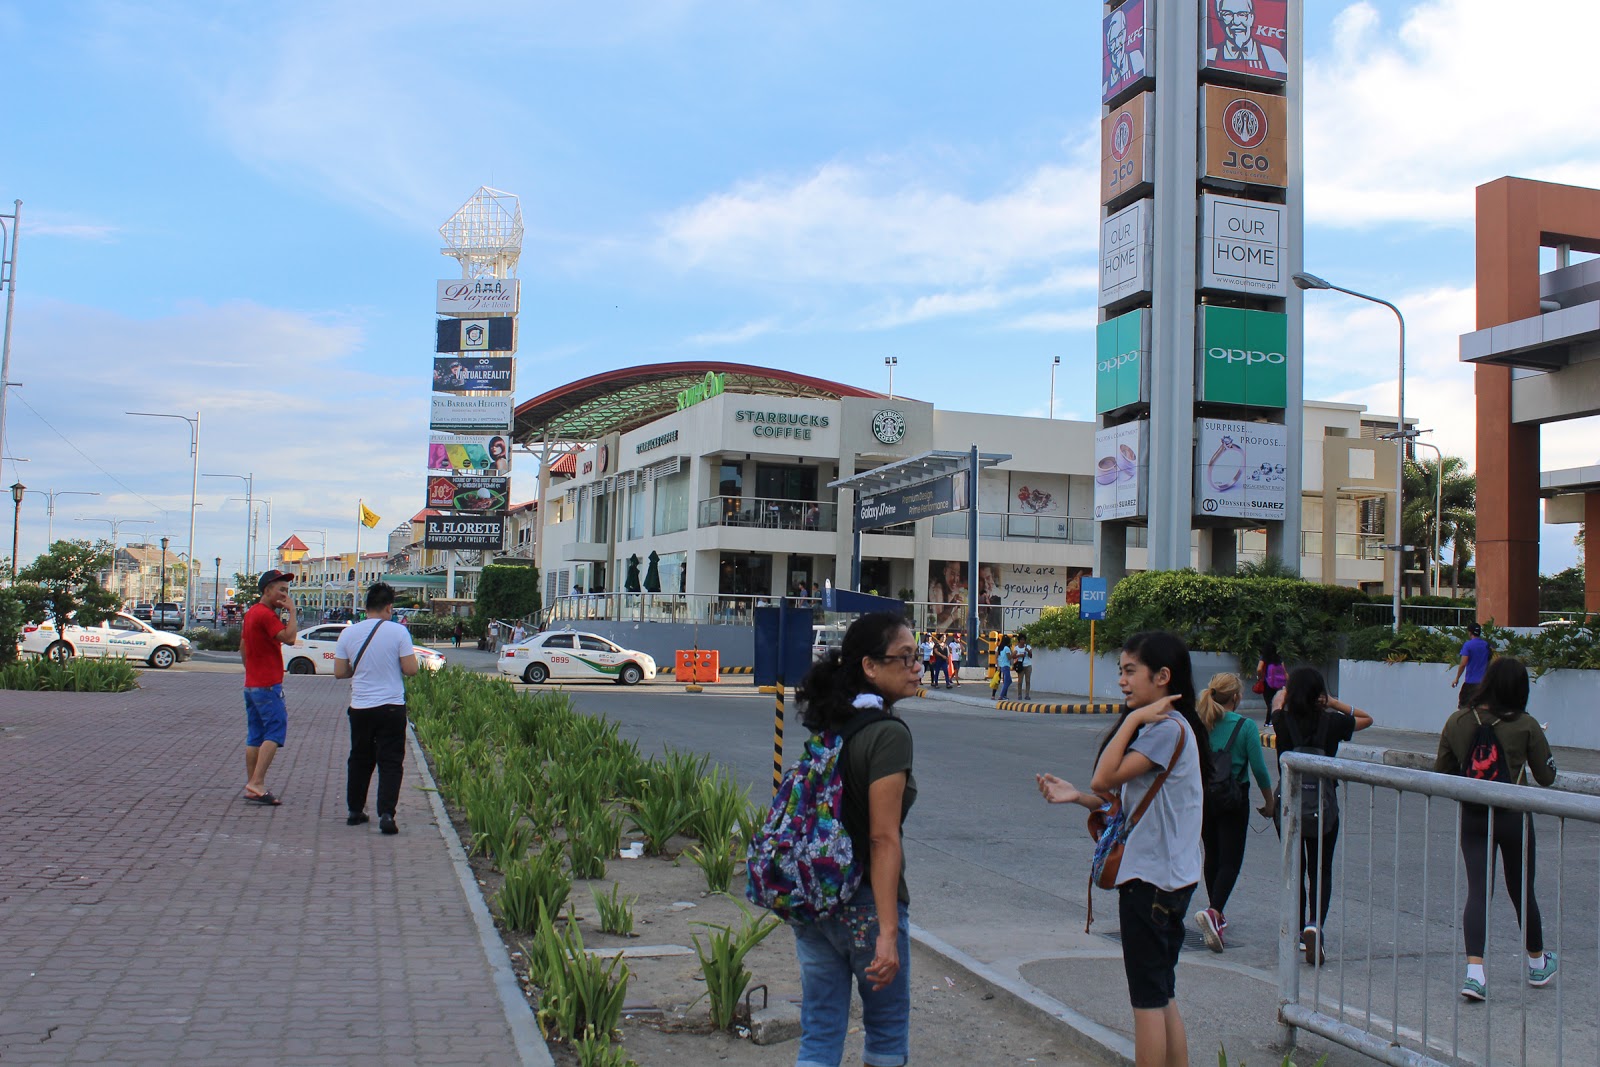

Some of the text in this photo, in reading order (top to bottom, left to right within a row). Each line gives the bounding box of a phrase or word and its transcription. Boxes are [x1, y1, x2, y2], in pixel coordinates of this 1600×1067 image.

[1127, 25, 1144, 47] KFC
[1255, 24, 1286, 40] KFC
[1110, 223, 1131, 245] OUR
[1227, 217, 1265, 236] OUR
[1104, 247, 1136, 276] HOME
[1216, 243, 1275, 266] HOME
[1215, 275, 1277, 291] www.ourhome.ph
[441, 283, 510, 311] Plazuela
[1097, 349, 1139, 373] oppo
[1208, 347, 1285, 365] oppo
[455, 370, 511, 380] VIRTUAL REALITY
[447, 400, 477, 408] BARBARA
[478, 399, 508, 408] HEIGHTS
[735, 410, 829, 428] STARBUCKS
[753, 425, 812, 441] COFFEE
[1205, 422, 1253, 434] SURPRISE...
[1240, 436, 1286, 447] PROPOSE...
[908, 500, 949, 515] Prime Performance
[1118, 499, 1137, 508] SUAREZ
[1251, 500, 1284, 510] SUAREZ
[860, 505, 879, 521] Galaxy
[885, 504, 896, 515] Prime
[428, 522, 501, 534] R. FLORETE
[428, 535, 457, 543] PAWNSHOP
[1012, 563, 1055, 576] We are
[1003, 579, 1064, 600] growing to
[1082, 590, 1106, 601] EXIT
[1004, 600, 1037, 619] offer
[79, 634, 101, 643] 0929
[323, 652, 336, 660] 188
[550, 656, 570, 664] 0895
